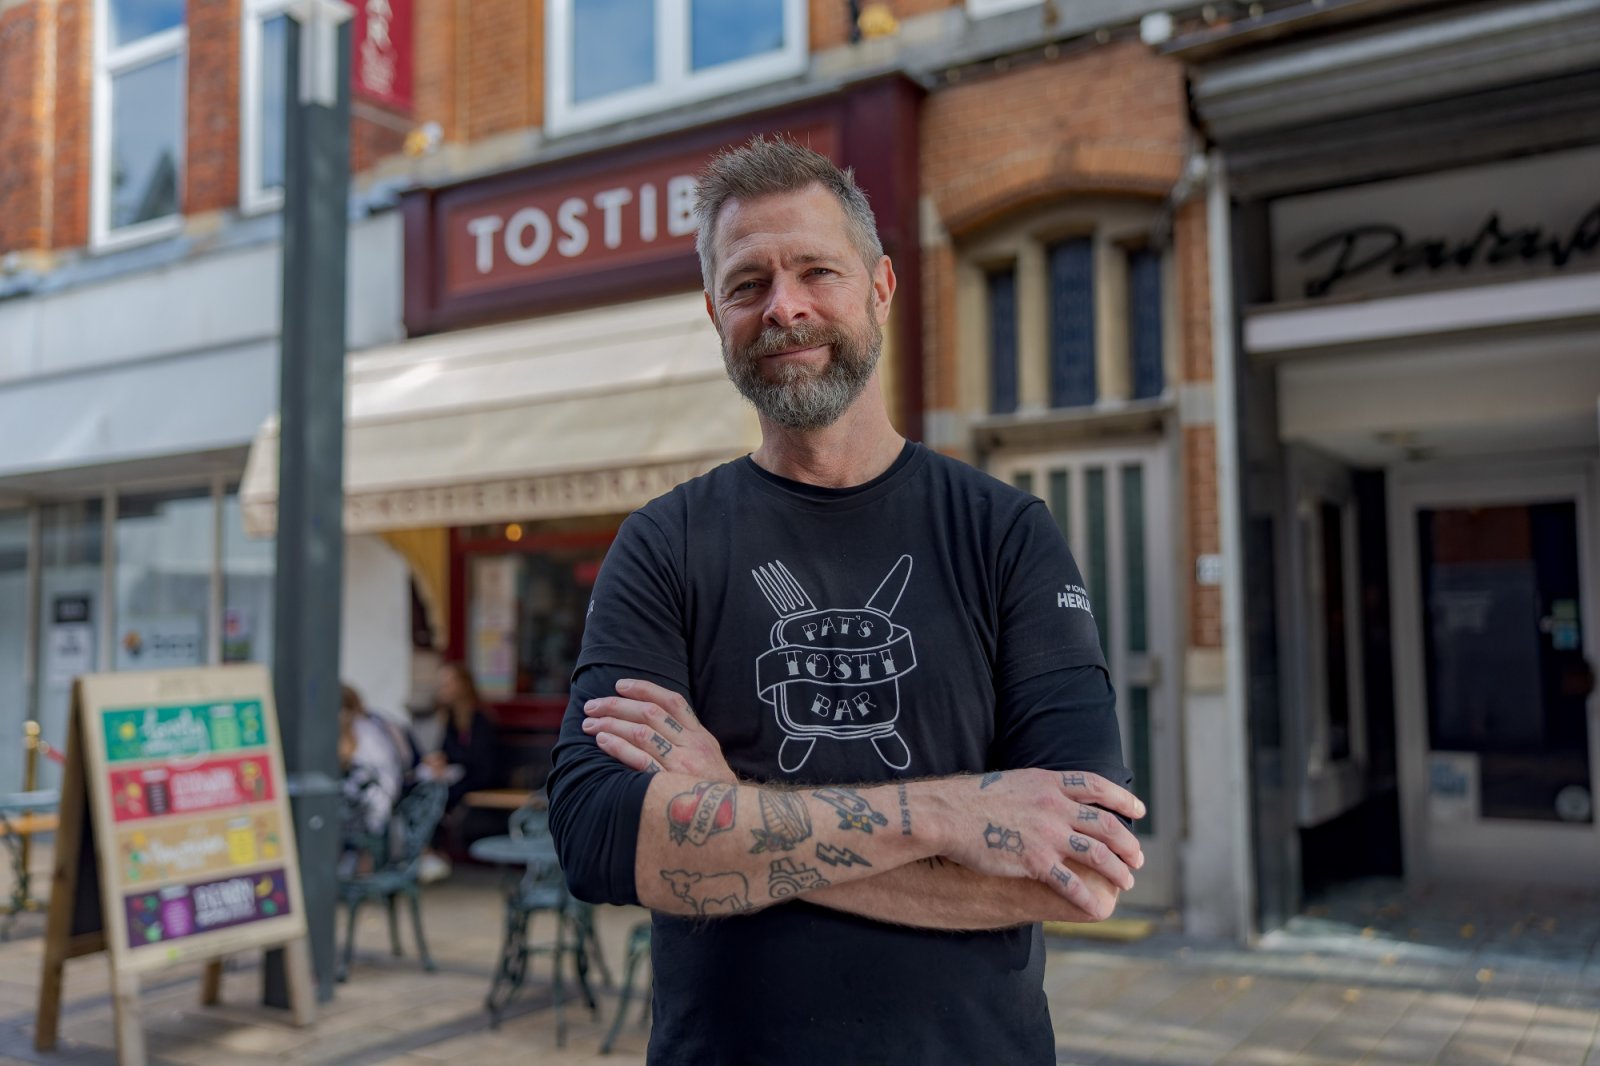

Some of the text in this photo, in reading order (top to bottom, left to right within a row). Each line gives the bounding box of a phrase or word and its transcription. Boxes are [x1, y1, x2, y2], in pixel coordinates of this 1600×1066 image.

[802, 615, 874, 641] PAT'S
[778, 649, 898, 680] TOSTI
[811, 691, 877, 721] BAR
